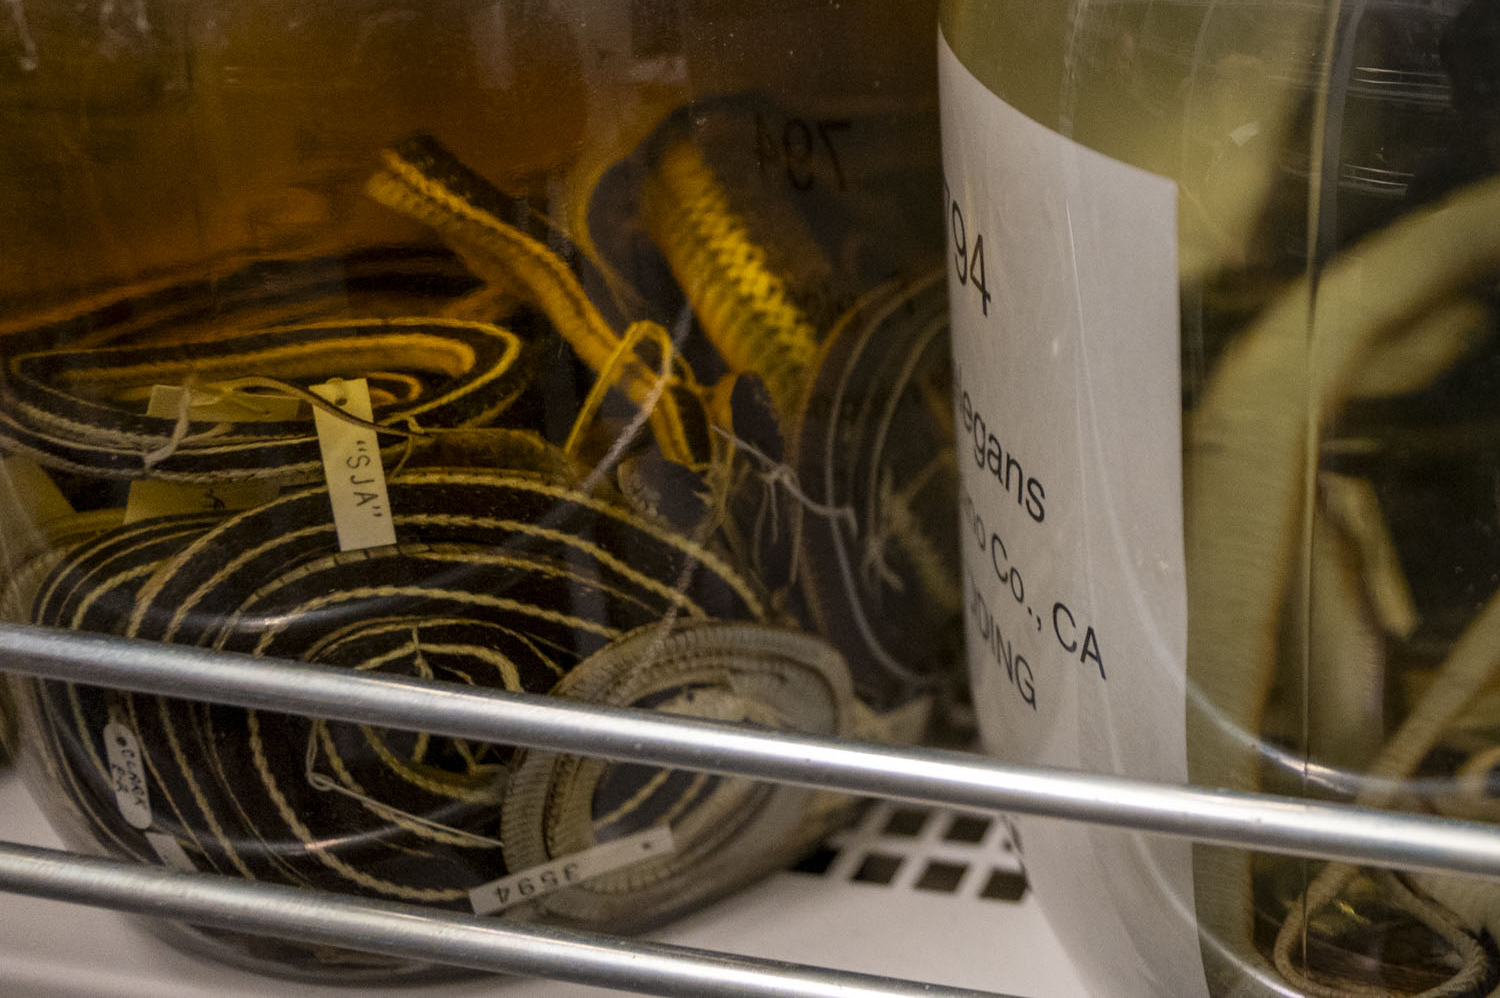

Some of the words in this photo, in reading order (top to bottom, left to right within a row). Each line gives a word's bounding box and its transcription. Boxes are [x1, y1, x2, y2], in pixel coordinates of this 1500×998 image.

[958, 374, 1047, 523] egans
[991, 532, 1042, 632] Co.,
[1052, 601, 1107, 681] CA
